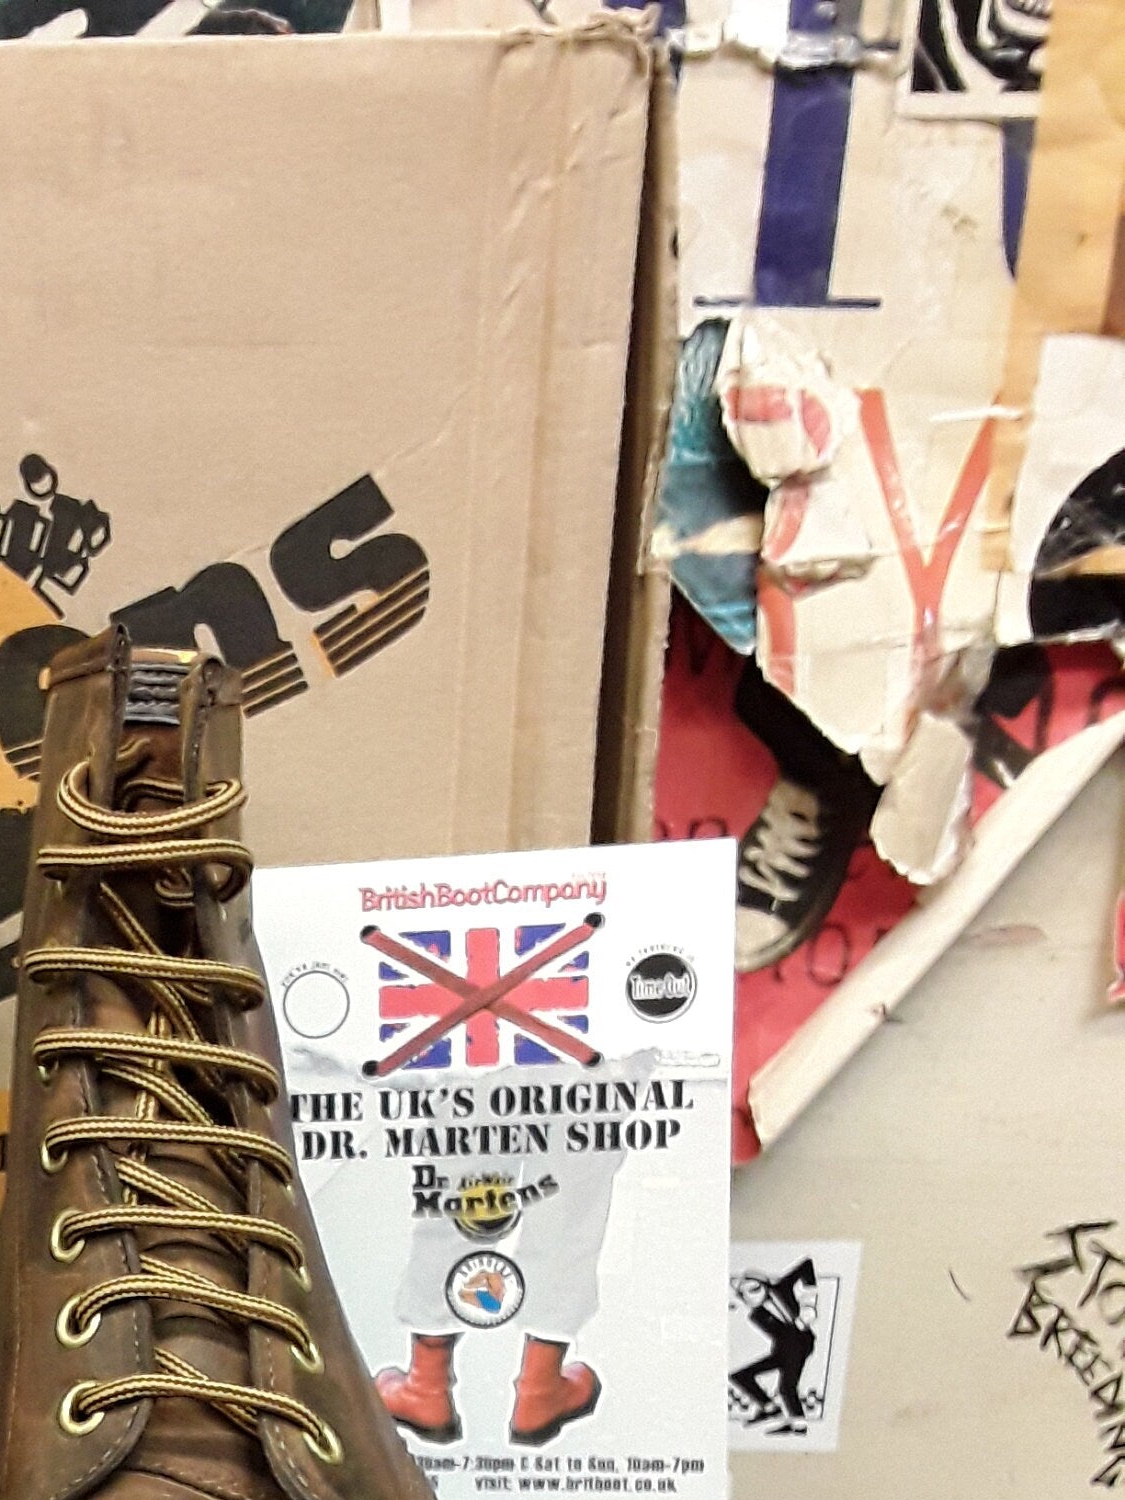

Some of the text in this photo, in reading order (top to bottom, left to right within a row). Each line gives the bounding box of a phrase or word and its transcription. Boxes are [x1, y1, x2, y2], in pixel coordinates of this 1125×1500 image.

[290, 1078, 695, 1122] THE UK'S ORIGINAL
[301, 1118, 682, 1161] DR. MARTEN SHOP
